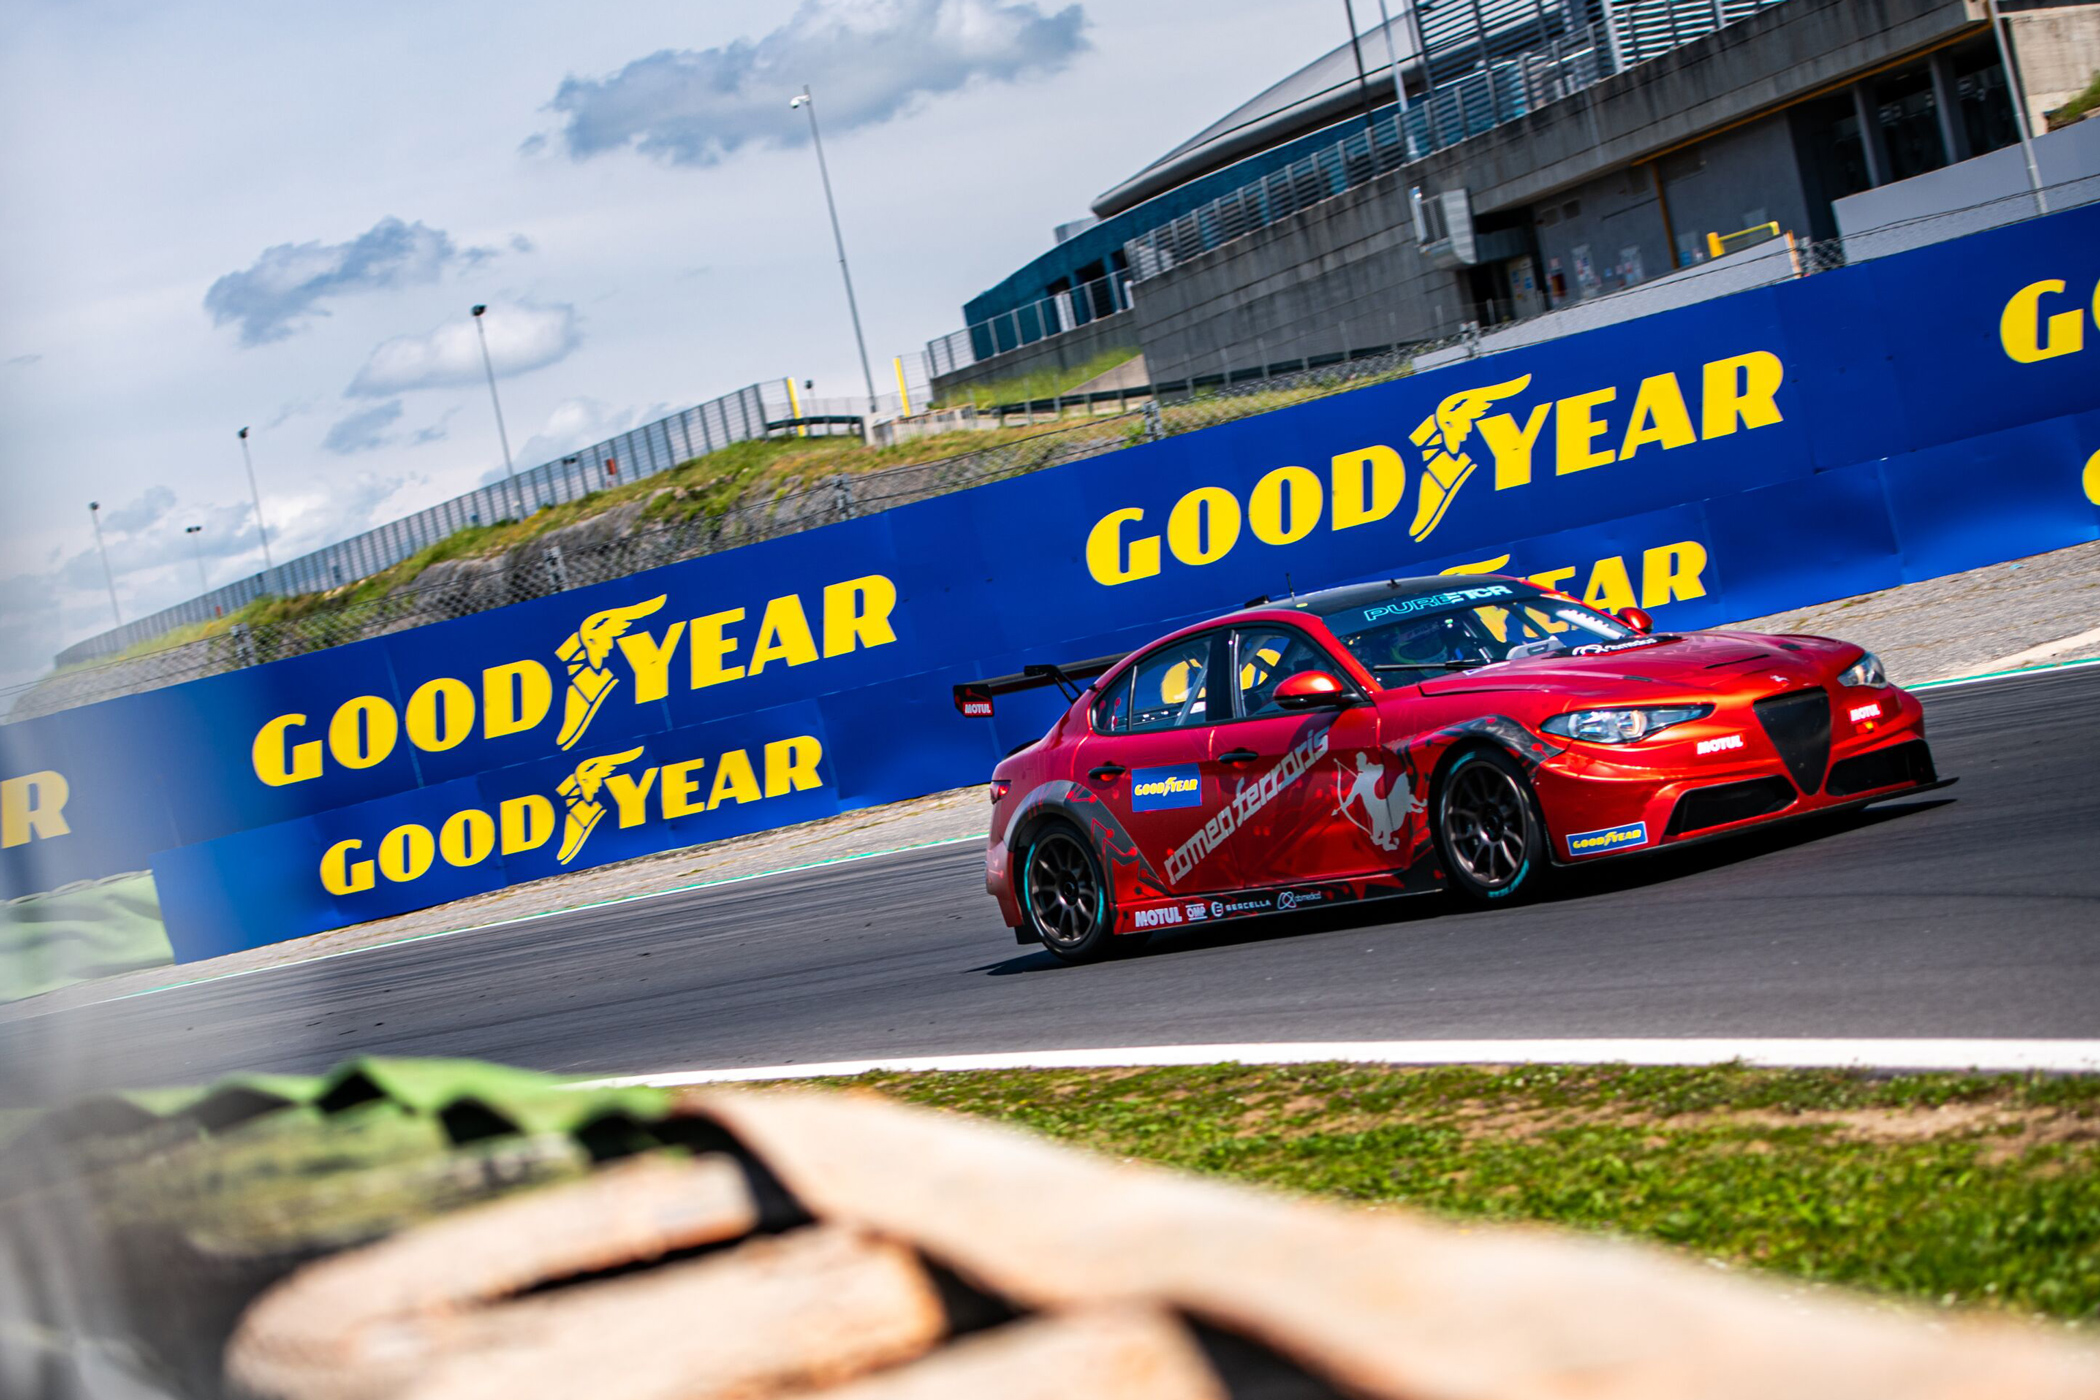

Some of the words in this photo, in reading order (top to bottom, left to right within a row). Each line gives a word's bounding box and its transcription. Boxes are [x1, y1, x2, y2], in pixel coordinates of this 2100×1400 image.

[1087, 350, 1783, 586] GOODYEAR
[252, 574, 897, 787] GOODYEAR
[964, 703, 992, 714] MOTUL
[1849, 704, 1881, 723] MOTUL
[1696, 734, 1744, 755] MOTUL
[1134, 776, 1199, 797] GOODYEAR
[320, 736, 822, 896] GOODYEAR
[1572, 829, 1642, 849] GOODYEAR
[1225, 899, 1272, 912] BERCELLA
[1134, 906, 1183, 928] MOTUL
